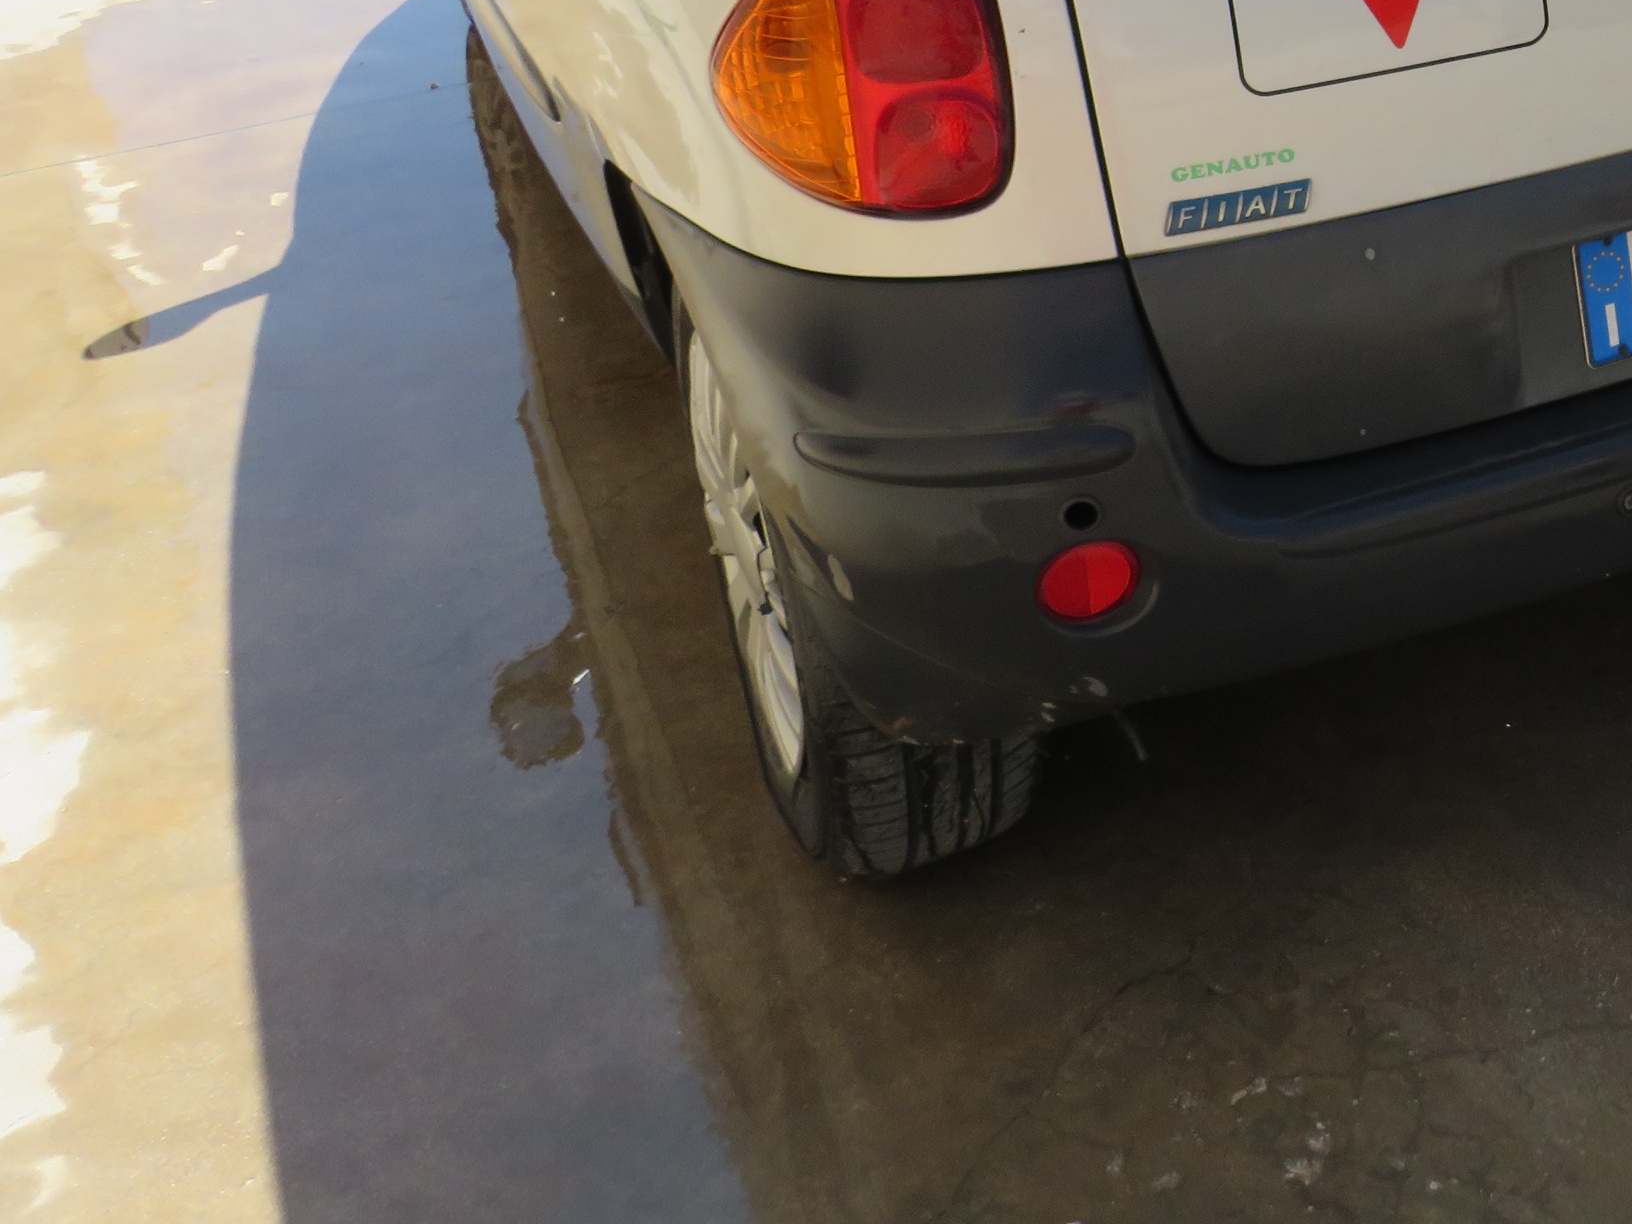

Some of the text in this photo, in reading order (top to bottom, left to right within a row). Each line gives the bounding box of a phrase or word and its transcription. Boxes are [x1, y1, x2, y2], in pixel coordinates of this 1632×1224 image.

[1170, 148, 1295, 183] GENAUTO
[1177, 187, 1303, 229] FIAT
[1604, 303, 1621, 347] I
